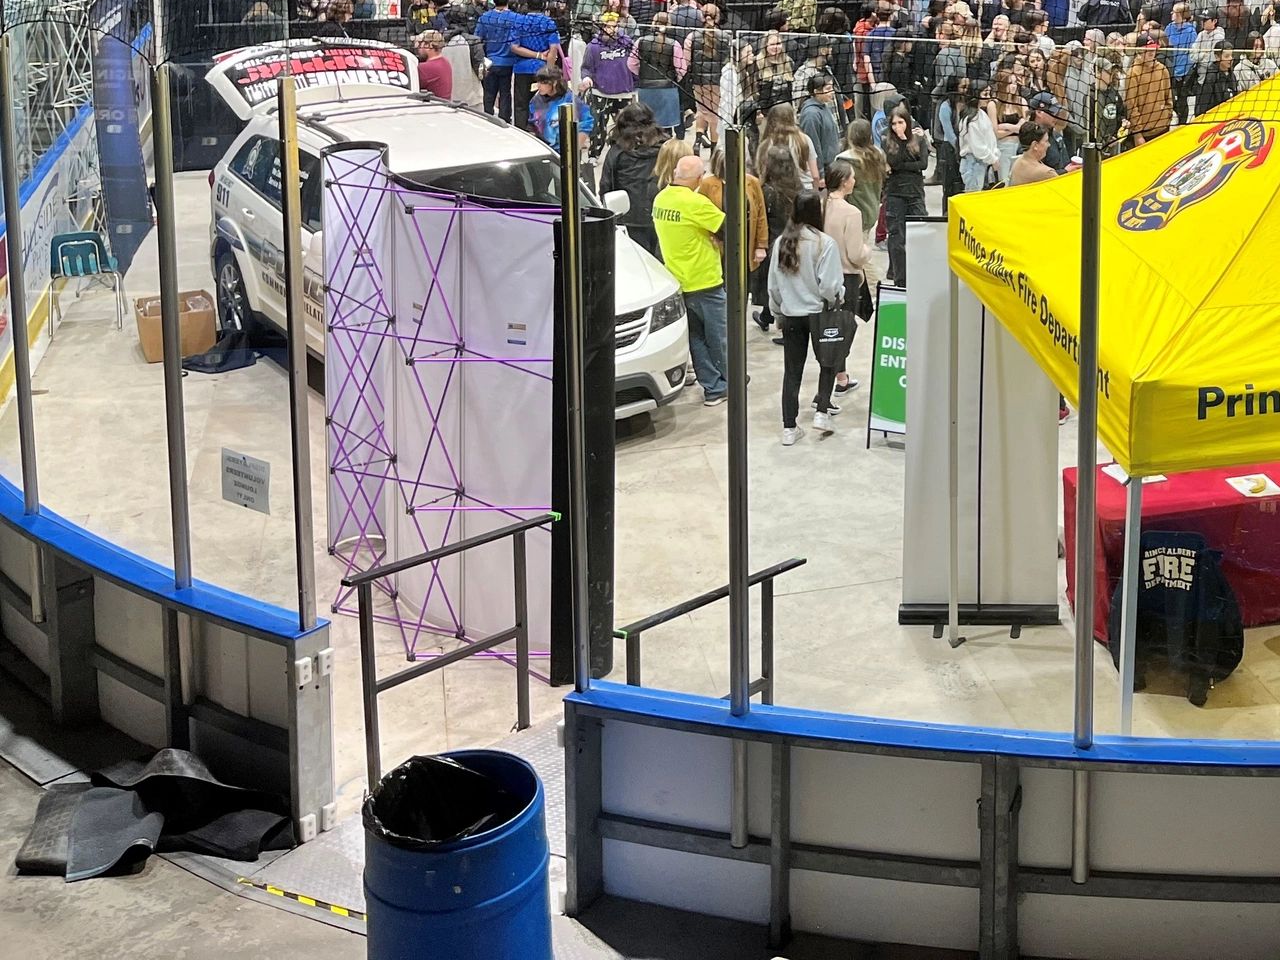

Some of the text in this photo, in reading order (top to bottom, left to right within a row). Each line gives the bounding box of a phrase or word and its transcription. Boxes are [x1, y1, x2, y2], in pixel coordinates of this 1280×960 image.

[216, 183, 230, 209] 911
[959, 217, 987, 263] Prince
[1018, 271, 1038, 315] Fire
[1167, 548, 1196, 558] ALBERT
[1143, 555, 1196, 582] FIRE
